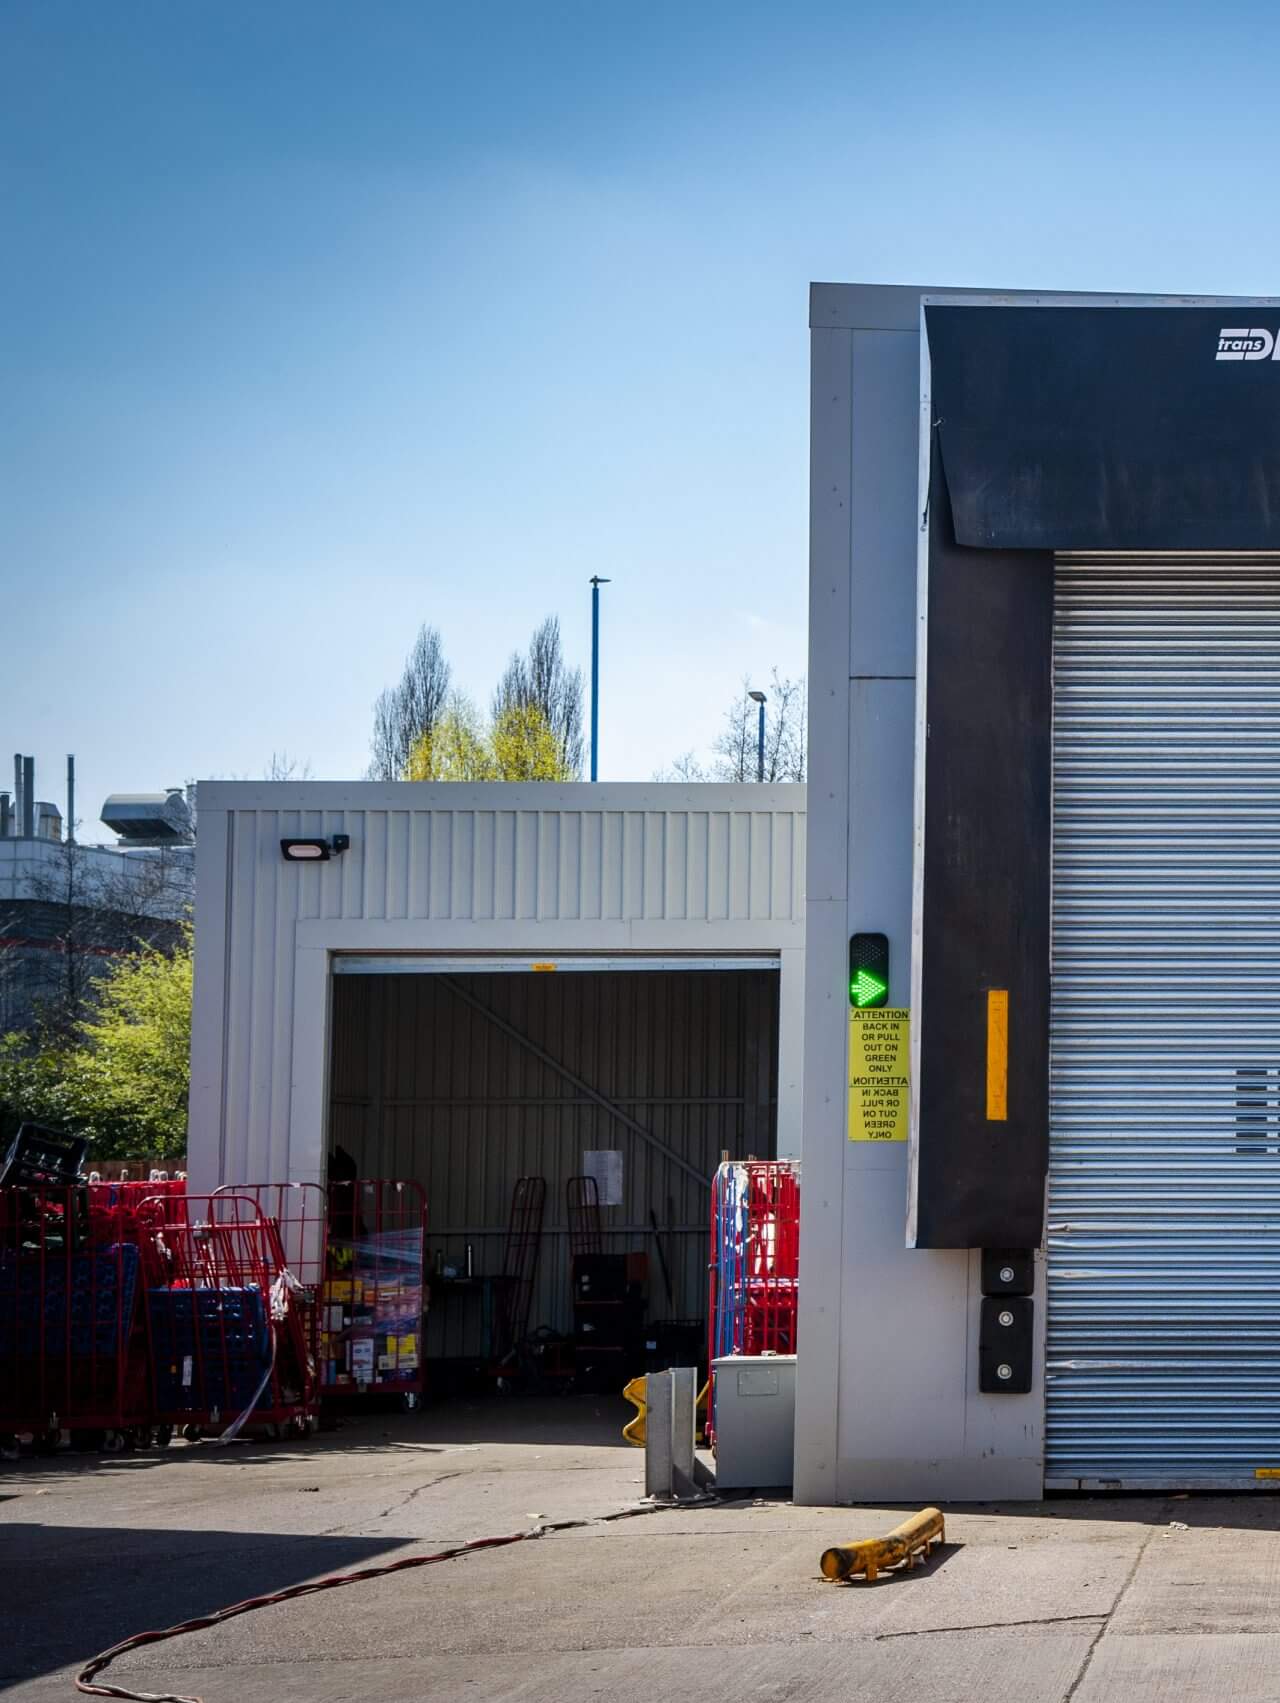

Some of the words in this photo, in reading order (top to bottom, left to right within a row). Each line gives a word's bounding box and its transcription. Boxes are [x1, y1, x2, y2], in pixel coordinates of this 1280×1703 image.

[853, 1010, 909, 1019] ATTENTION
[862, 1022, 888, 1031] BACK
[890, 1022, 900, 1030] IN
[861, 1033, 875, 1041] OR
[877, 1033, 900, 1041] PULL
[863, 1043, 882, 1051] OUT
[884, 1043, 898, 1051] ON
[864, 1054, 897, 1062] GREEN
[868, 1064, 893, 1072] ONLY
